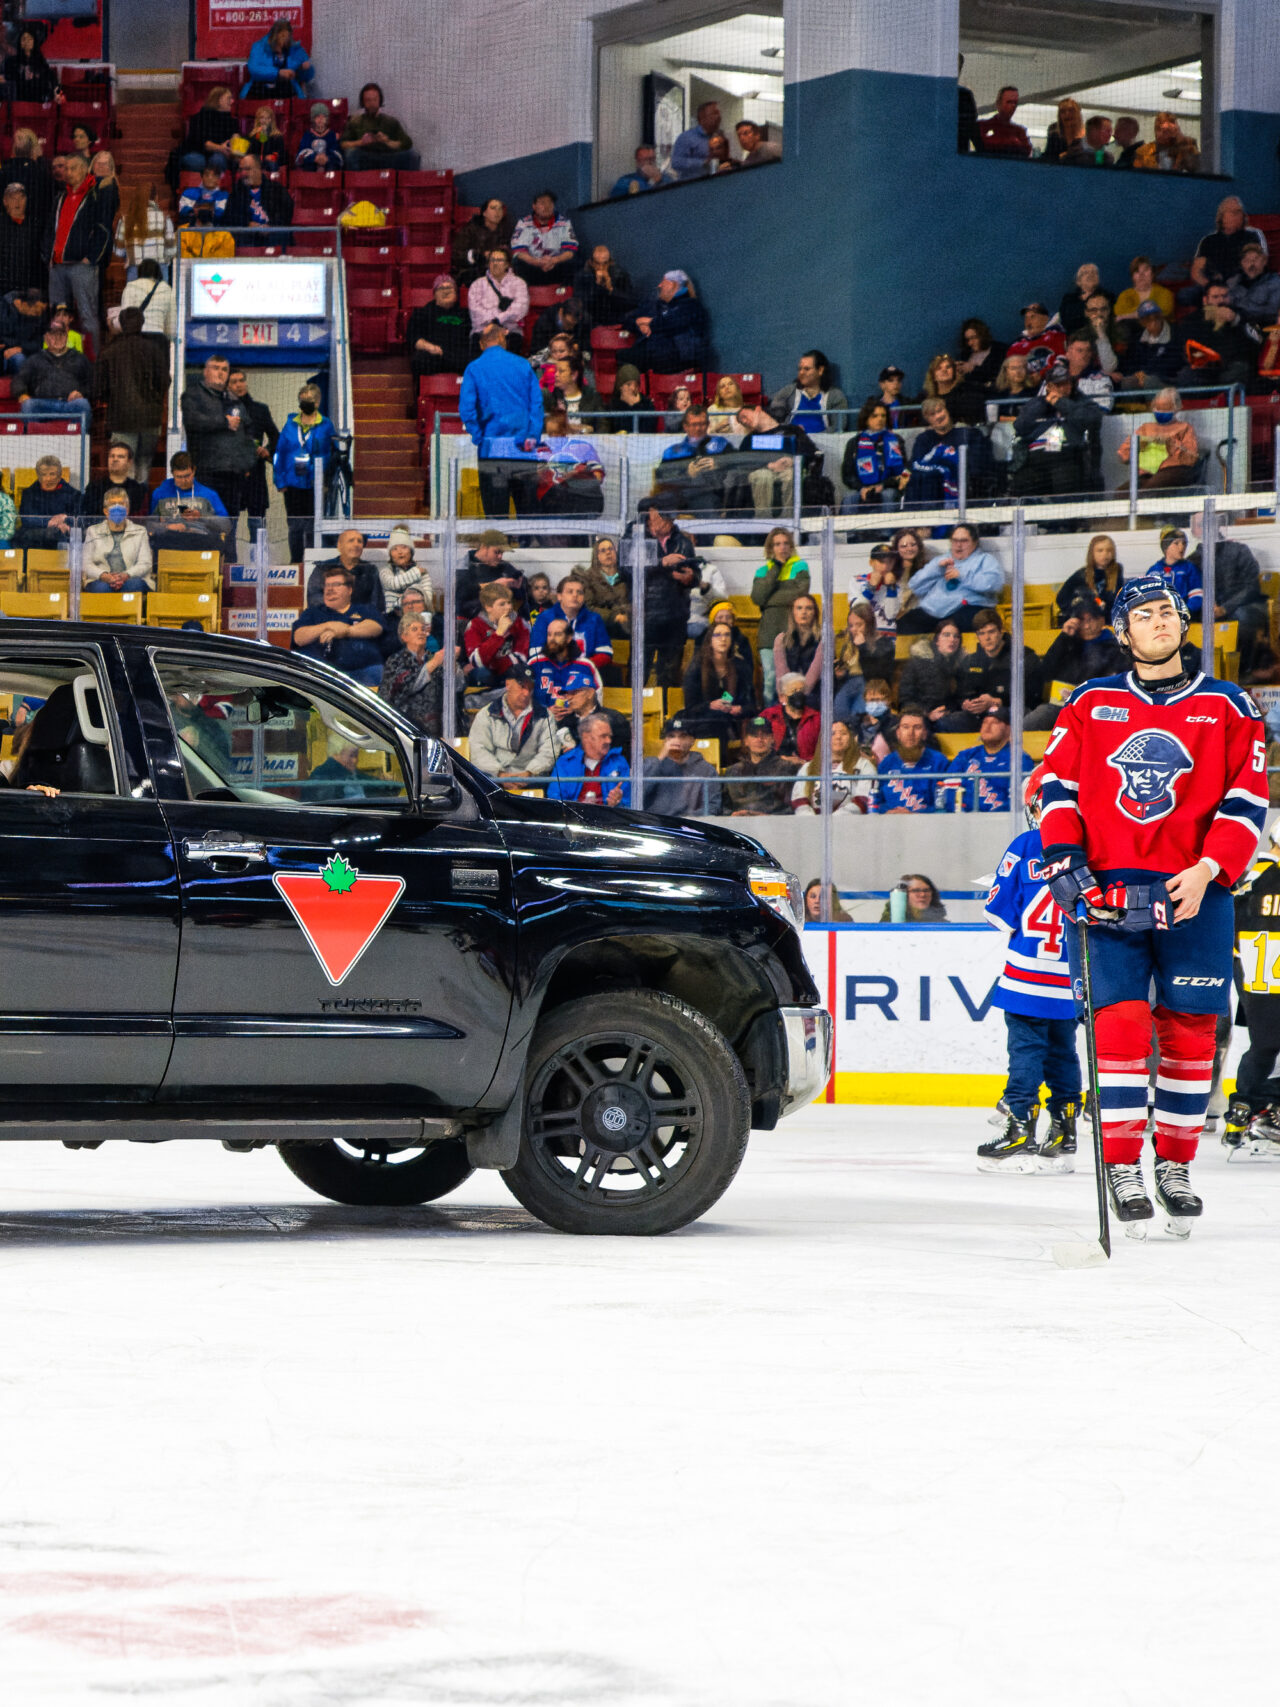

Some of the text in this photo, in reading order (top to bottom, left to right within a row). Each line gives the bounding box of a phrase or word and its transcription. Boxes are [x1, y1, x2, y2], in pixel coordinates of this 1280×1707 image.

[216, 324, 229, 343] 2
[241, 323, 274, 345] EXIT
[286, 322, 301, 343] 4
[1185, 715, 1218, 724] CCM
[1045, 727, 1068, 756] 7
[1252, 740, 1266, 773] 5
[1262, 894, 1280, 916] SI
[1022, 884, 1067, 961] 4
[1172, 976, 1225, 988] CCM
[317, 998, 423, 1012] TUNDRA
